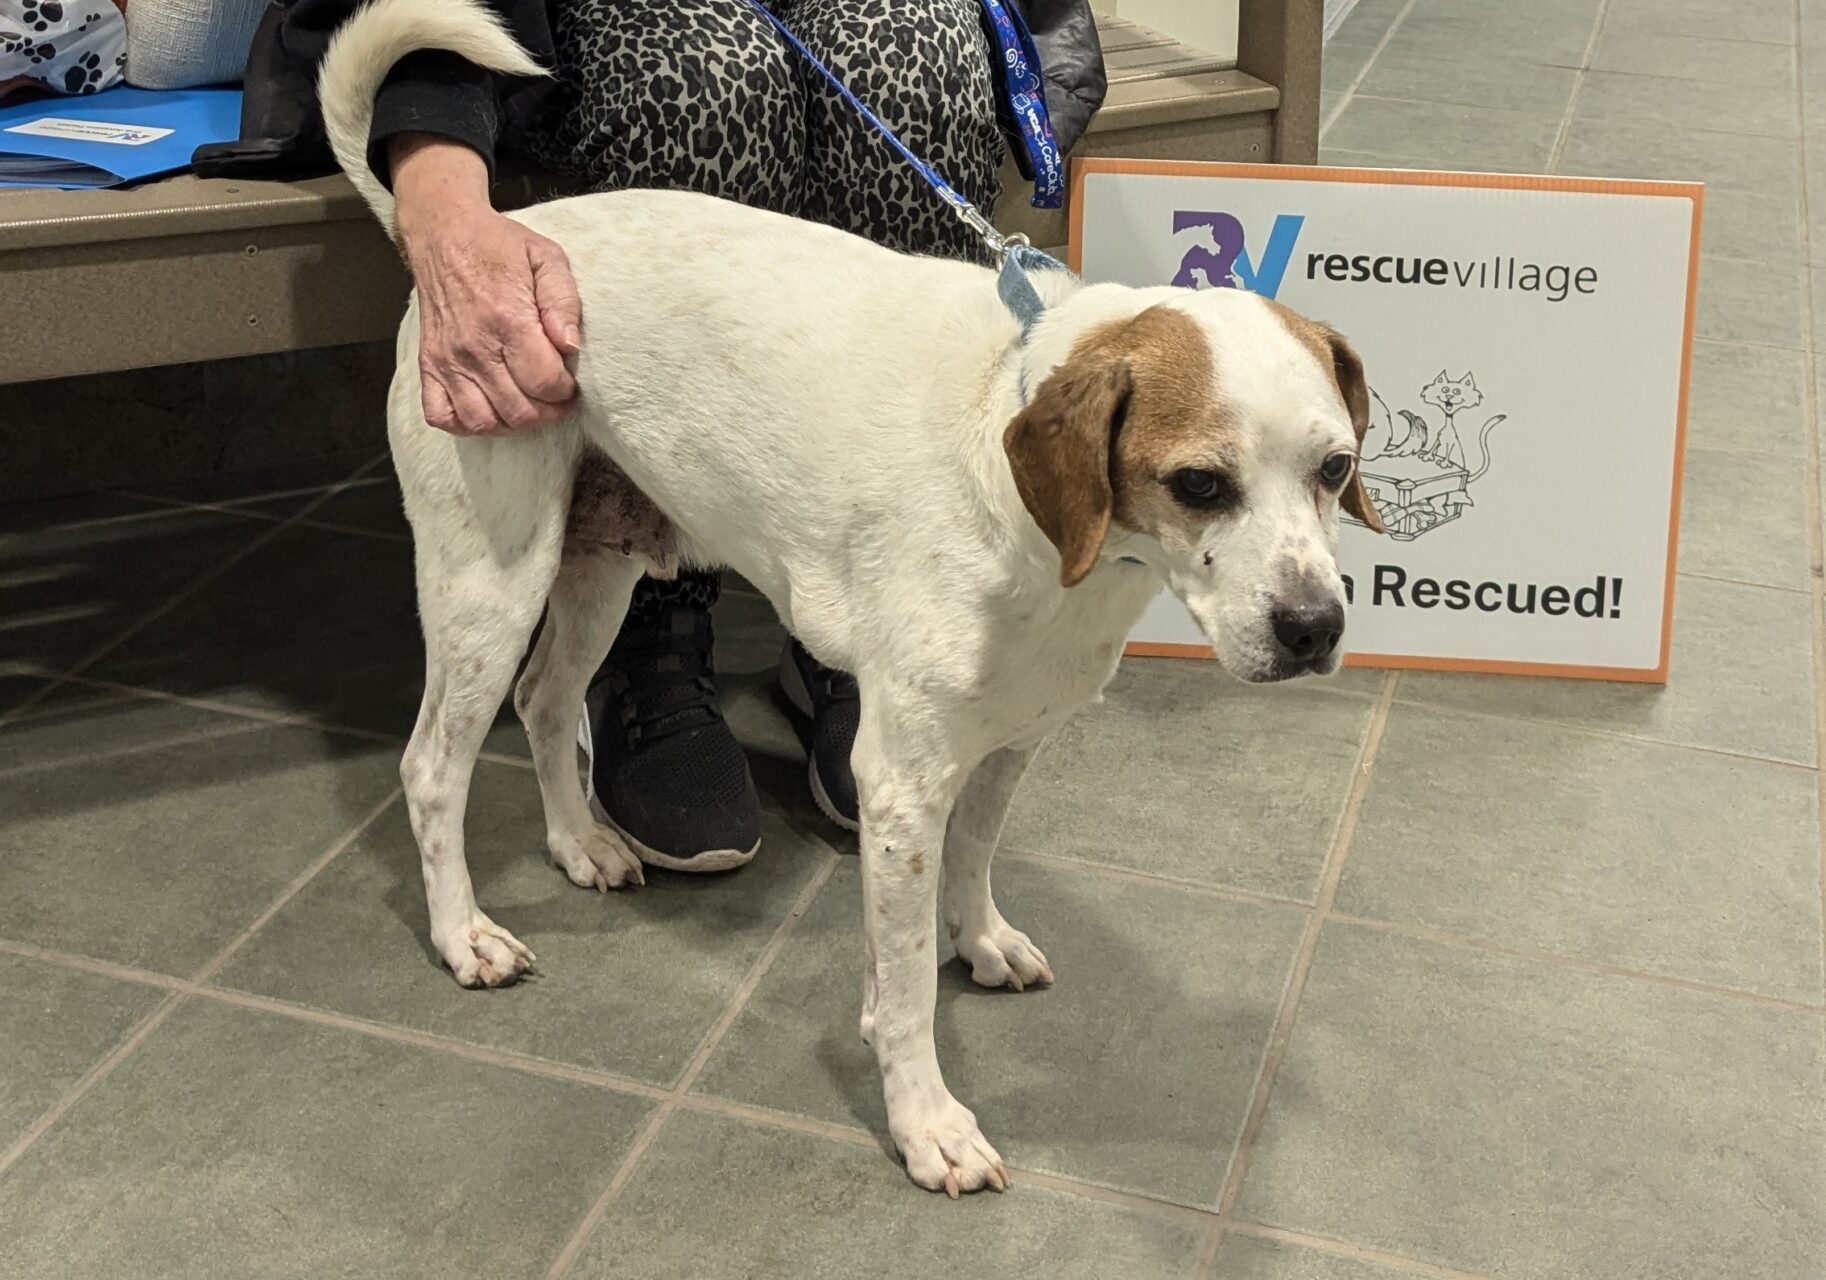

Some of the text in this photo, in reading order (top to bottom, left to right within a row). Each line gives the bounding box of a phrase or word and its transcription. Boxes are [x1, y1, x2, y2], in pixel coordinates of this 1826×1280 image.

[1027, 108, 1041, 133] VCA
[1170, 210, 1305, 300] RV
[1372, 564, 1623, 619] Rescued!
